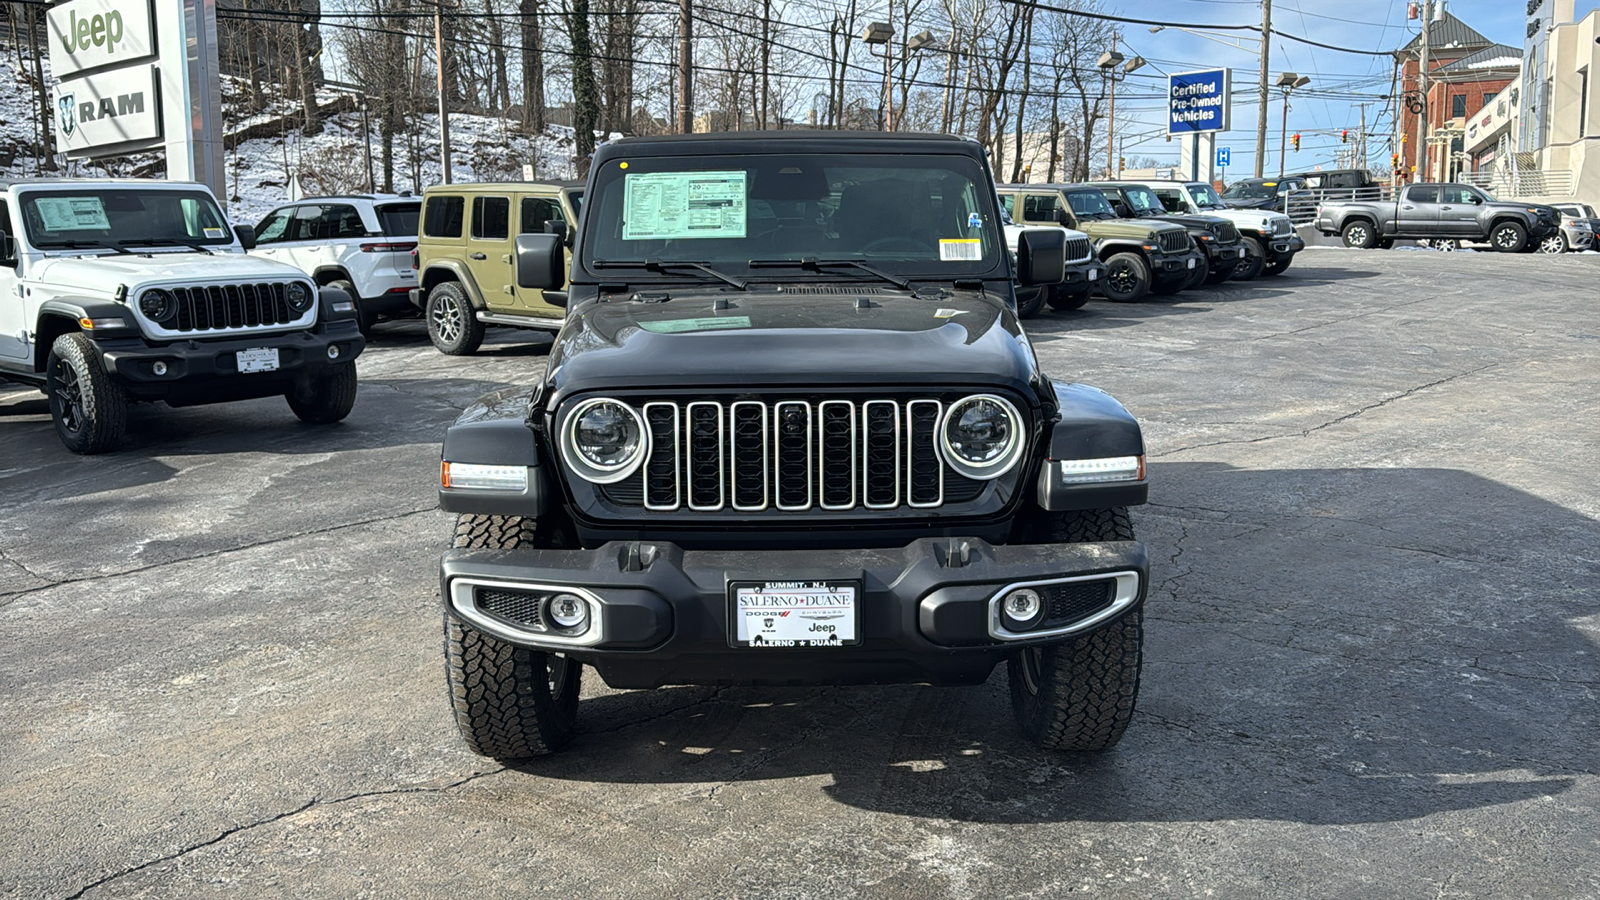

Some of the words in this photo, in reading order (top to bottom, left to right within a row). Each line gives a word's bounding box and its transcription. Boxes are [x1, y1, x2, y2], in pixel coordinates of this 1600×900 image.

[63, 9, 123, 54] Jeep
[1172, 82, 1215, 96] Certified
[79, 92, 145, 123] RAM
[1172, 95, 1221, 109] Pre-Owned
[1172, 110, 1214, 123] Vehicles
[1219, 151, 1228, 161] H
[740, 595, 798, 606] SALERNO
[806, 595, 850, 605] DUANE
[809, 623, 836, 633] Jeep
